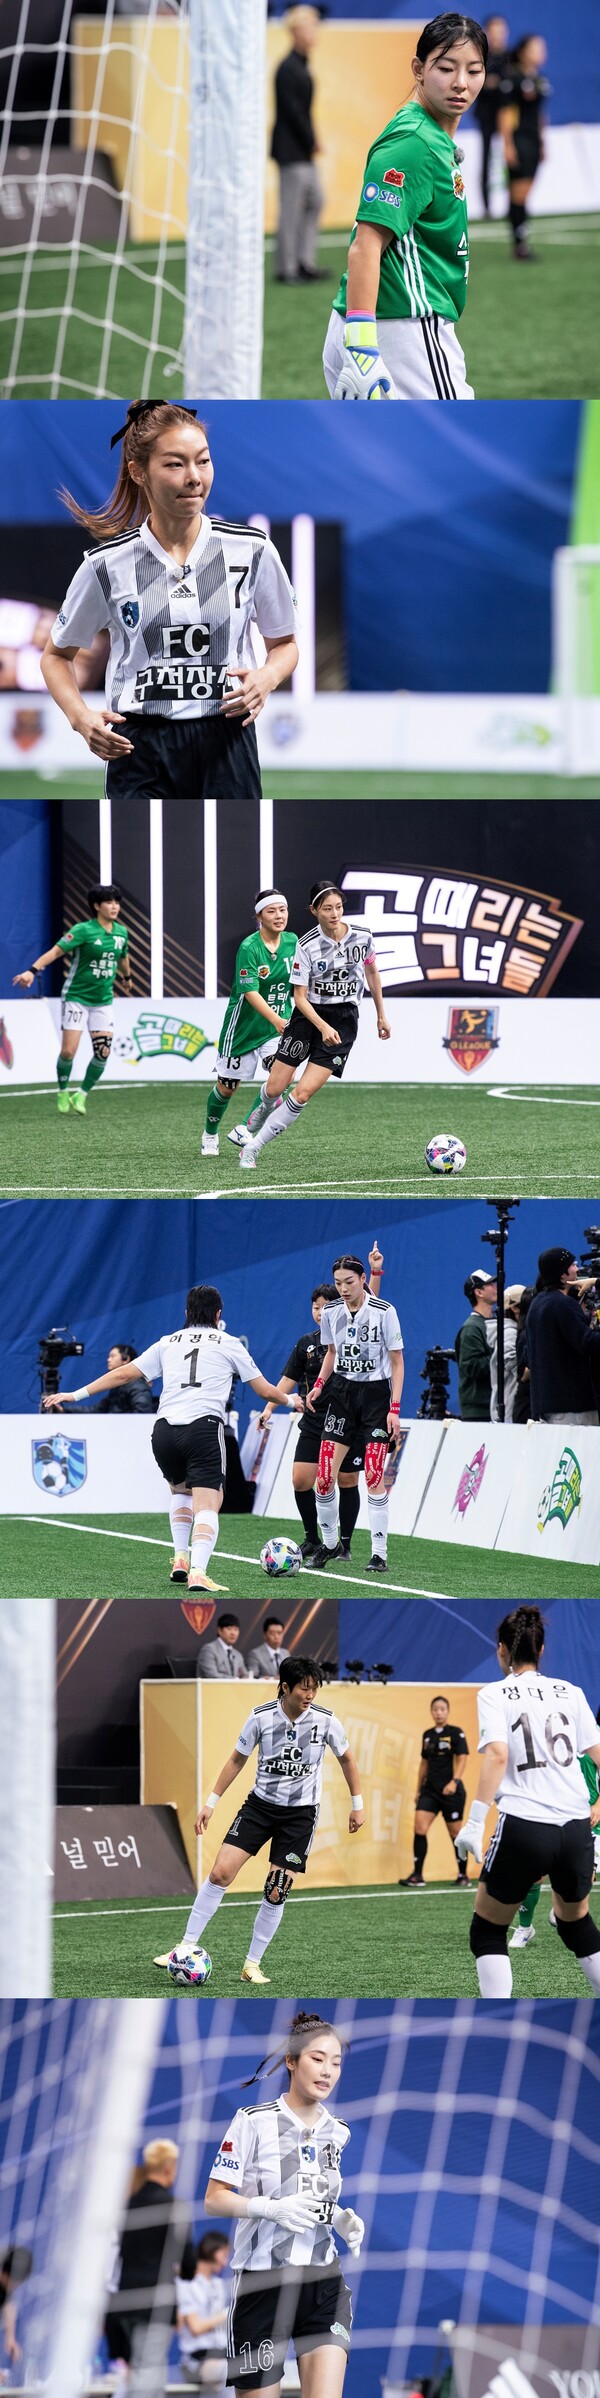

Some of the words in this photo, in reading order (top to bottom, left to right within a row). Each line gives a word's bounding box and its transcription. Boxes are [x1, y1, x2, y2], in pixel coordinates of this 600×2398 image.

[379, 190, 402, 208] SBS
[229, 566, 249, 609] 7
[162, 624, 210, 658] FC
[422, 877, 563, 952] 때리는
[343, 945, 367, 965] 100
[421, 932, 546, 995] 그녀들
[331, 969, 349, 981] FC
[270, 983, 286, 993] FC
[67, 1010, 83, 1023] 707
[226, 1056, 241, 1070] 13
[360, 1325, 380, 1343] 31
[342, 1344, 360, 1358] FC
[181, 1348, 202, 1389] 1
[325, 1414, 346, 1437] 31
[501, 1684, 569, 1701] 정다은
[309, 1724, 319, 1744] 1
[511, 1711, 574, 1773] 16
[281, 1746, 303, 1761] FC
[229, 1816, 242, 1837] 1
[60, 1837, 88, 1870] 널
[93, 1835, 142, 1869] 믿어
[221, 2157, 241, 2170] SBS
[297, 2173, 330, 2198] FC
[240, 2339, 275, 2374] 16
